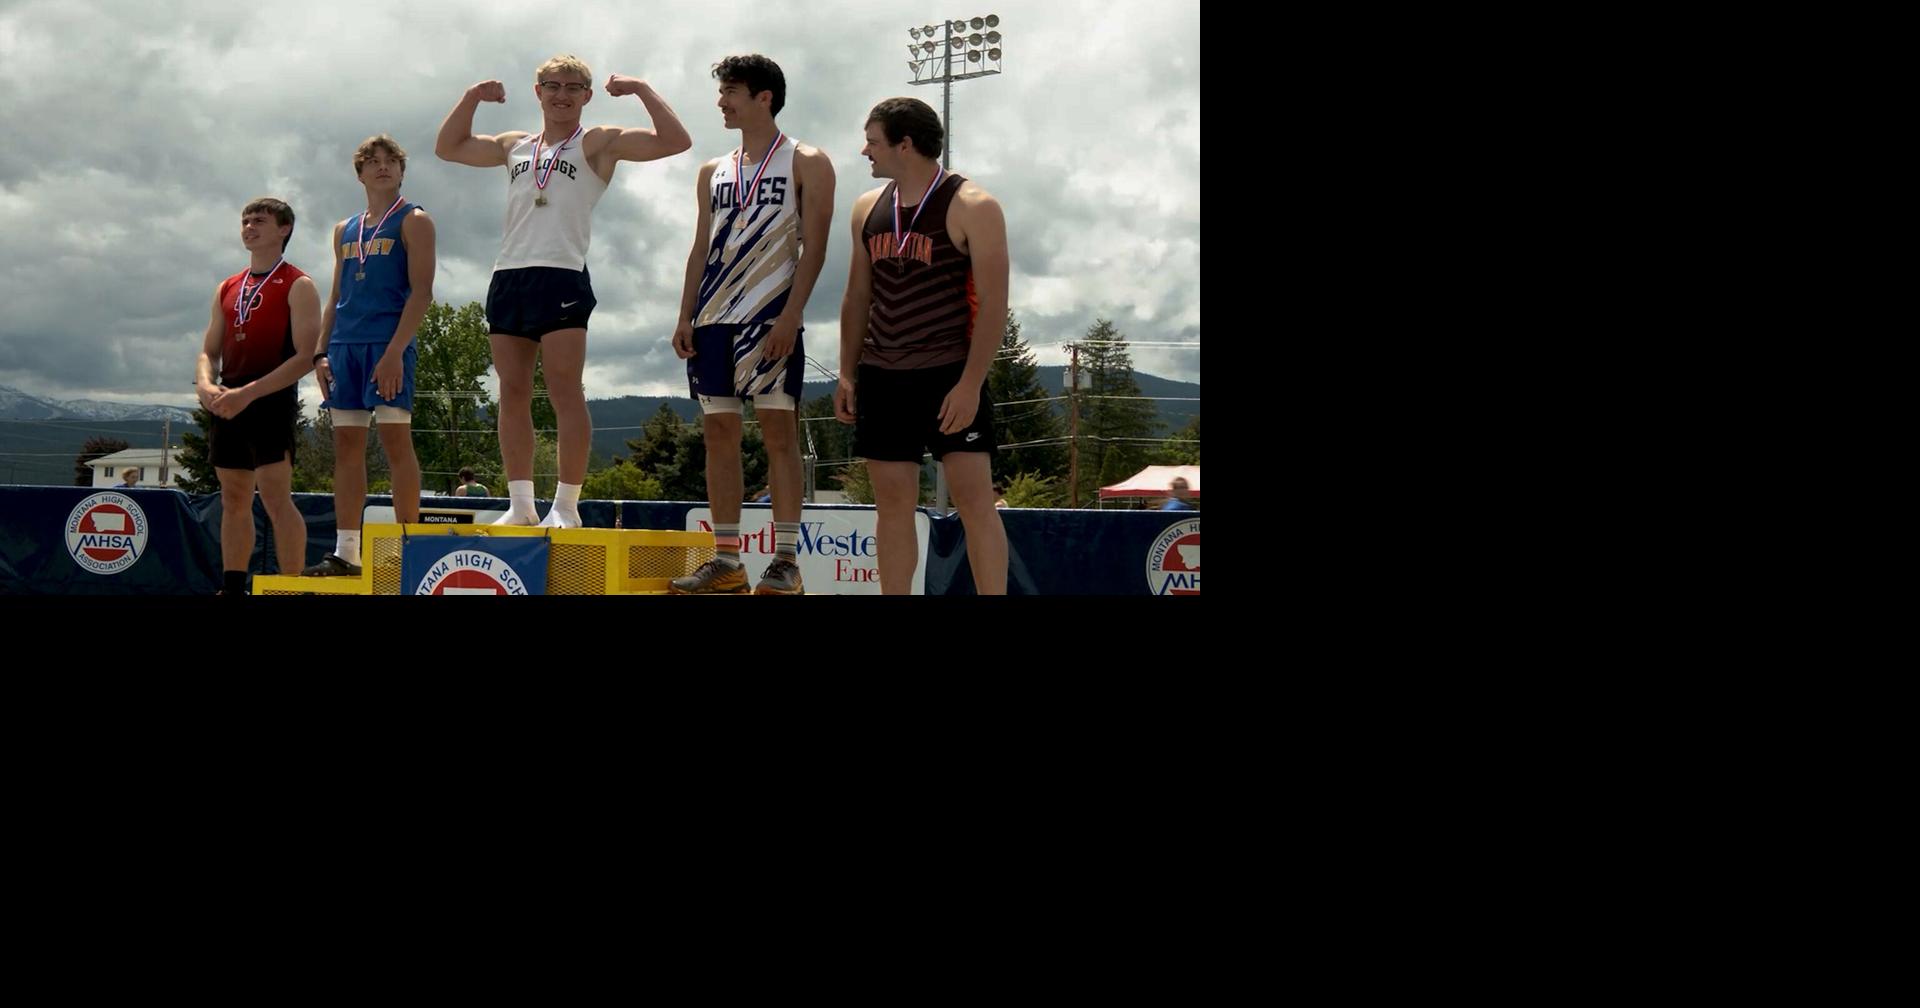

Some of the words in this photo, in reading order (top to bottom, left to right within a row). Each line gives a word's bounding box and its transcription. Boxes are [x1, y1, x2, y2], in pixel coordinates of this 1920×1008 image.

[70, 499, 97, 534] MONTANA
[101, 495, 124, 506] HIGH
[126, 504, 145, 537] SCHOOL
[424, 516, 458, 524] MONTANA
[73, 534, 138, 559] MHSA
[78, 553, 132, 571] ASSOCIATION
[1151, 528, 1184, 571] MONTANA
[418, 561, 450, 595] TANA
[455, 553, 493, 571] HIGH
[499, 568, 525, 595] SCH
